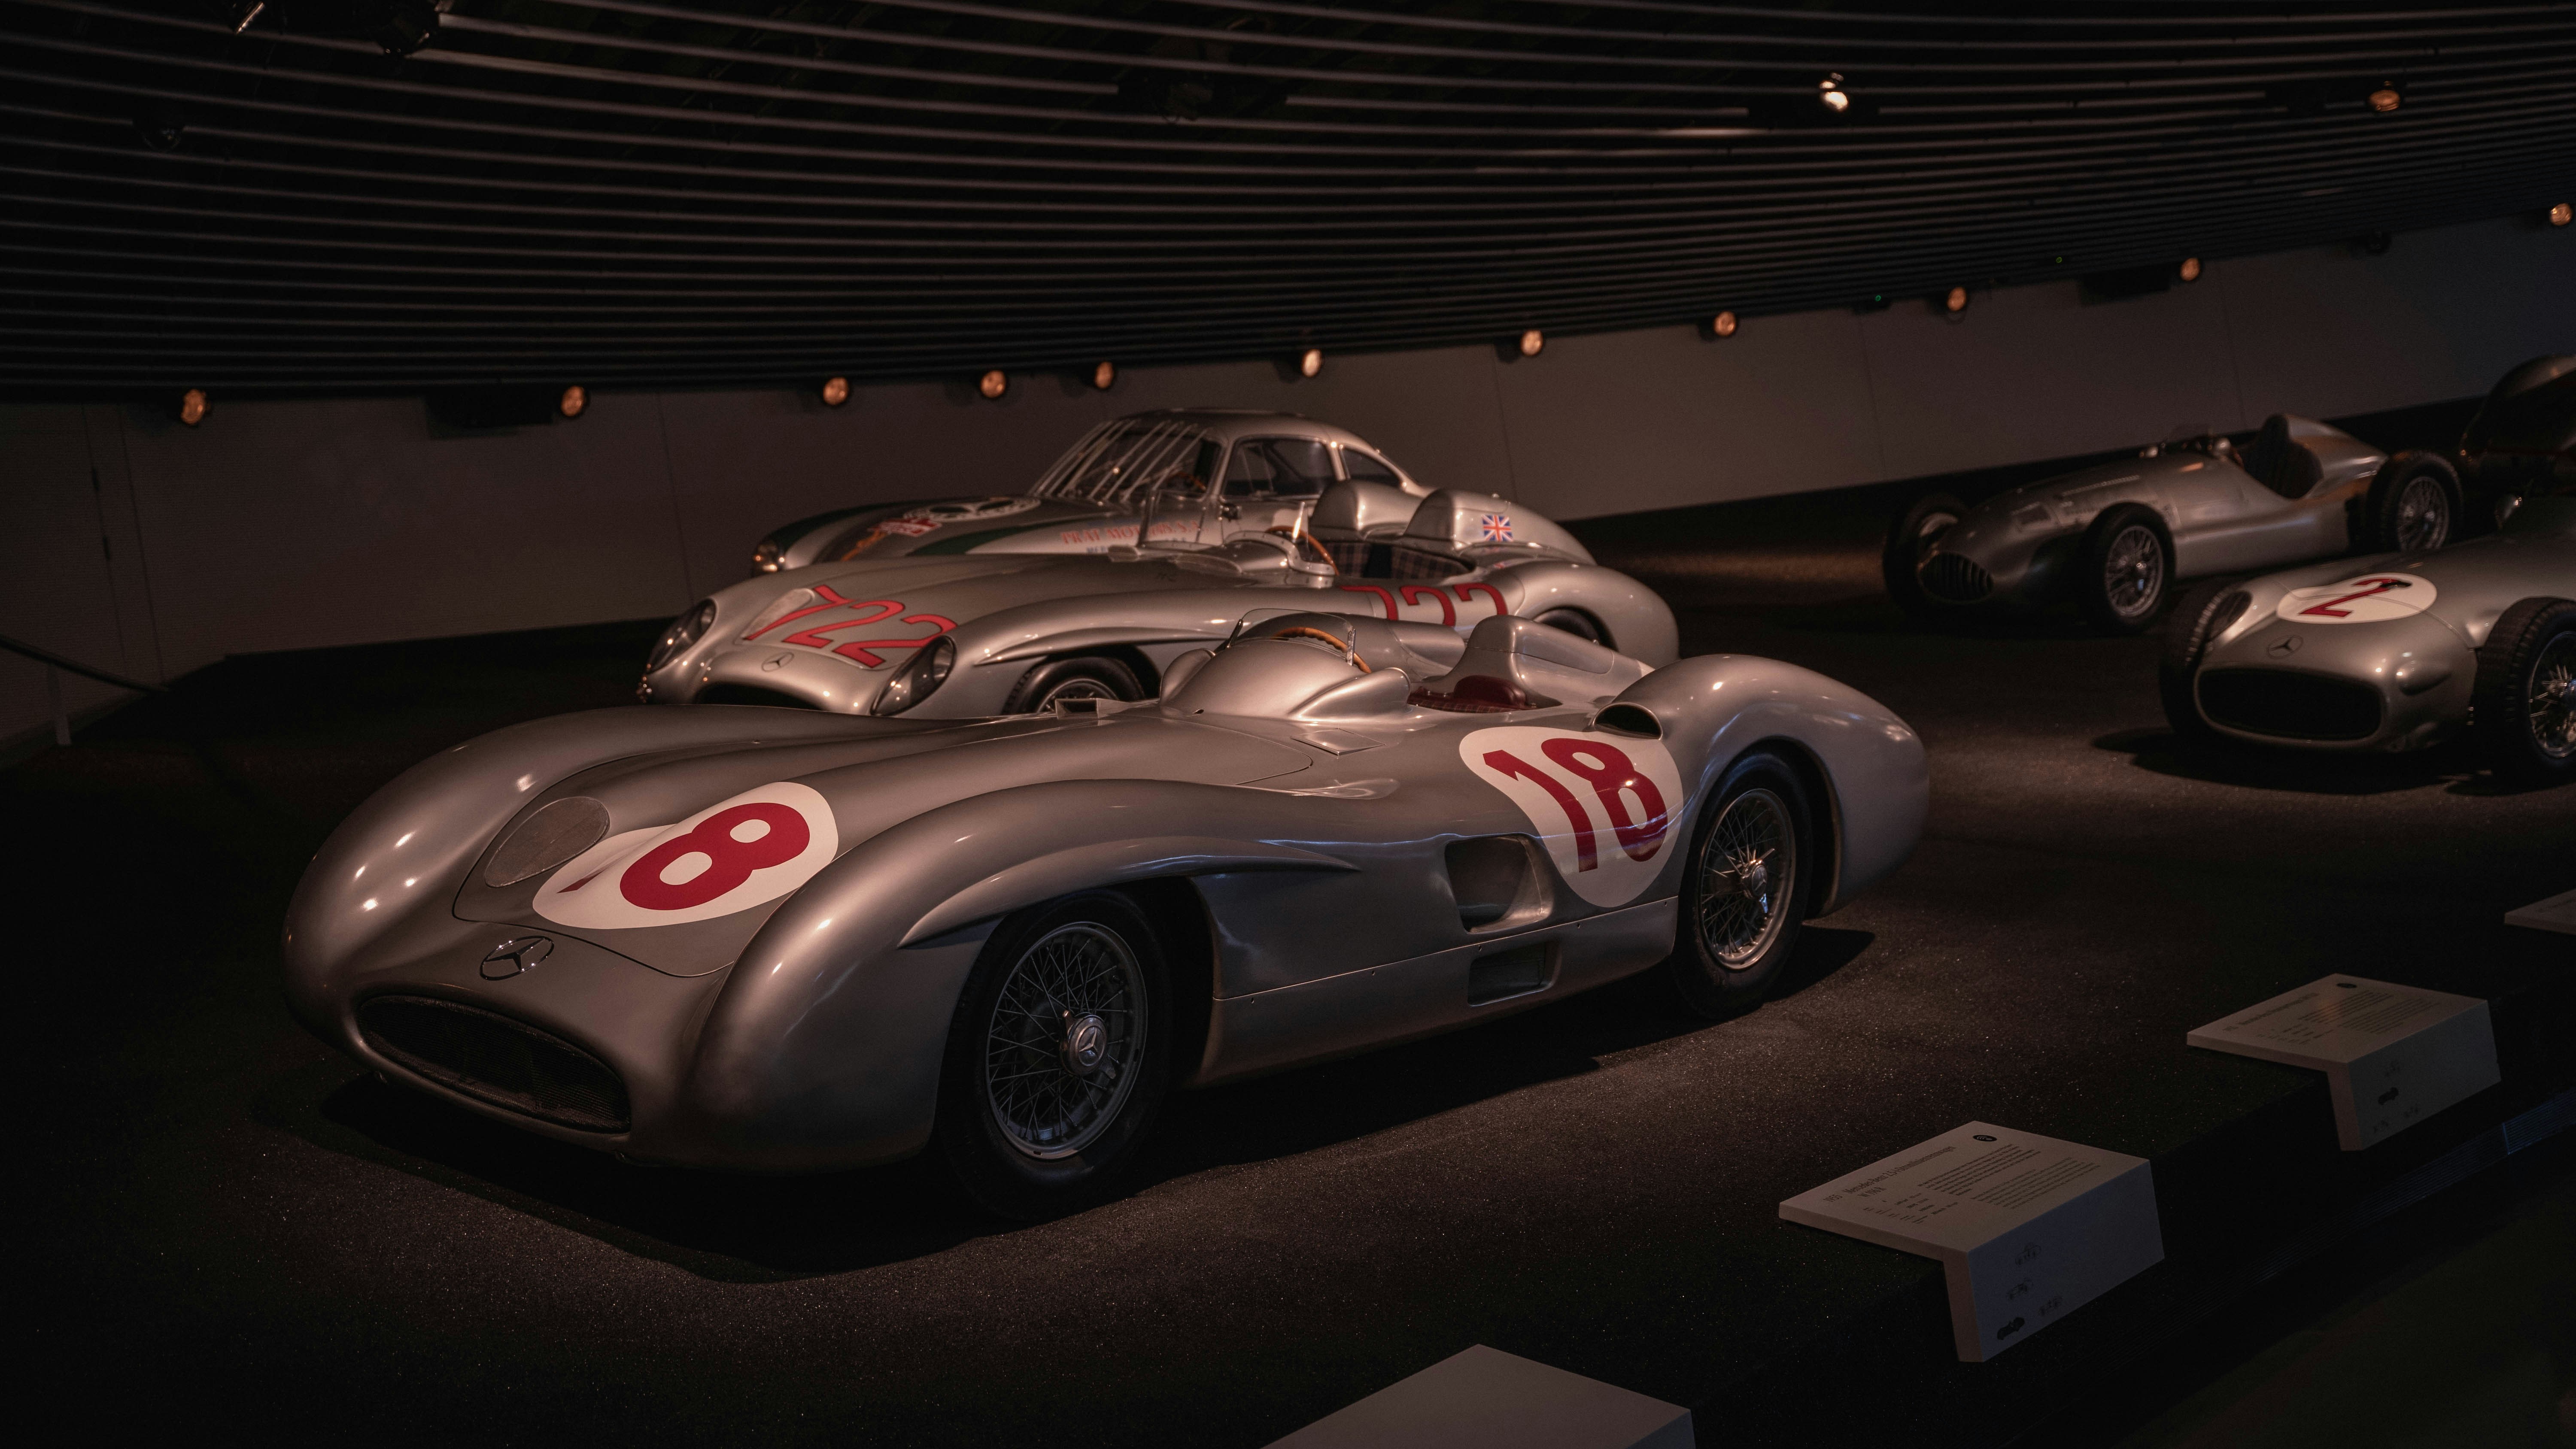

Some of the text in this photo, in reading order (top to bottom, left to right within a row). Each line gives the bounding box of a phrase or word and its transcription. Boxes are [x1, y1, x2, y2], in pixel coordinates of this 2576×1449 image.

[743, 585, 958, 668] 722
[2300, 579, 2399, 617] 2
[1482, 738, 1668, 873] 18
[1823, 1194, 1843, 1202] 1955
[1842, 1174, 1889, 1194] Mercedes-Benz
